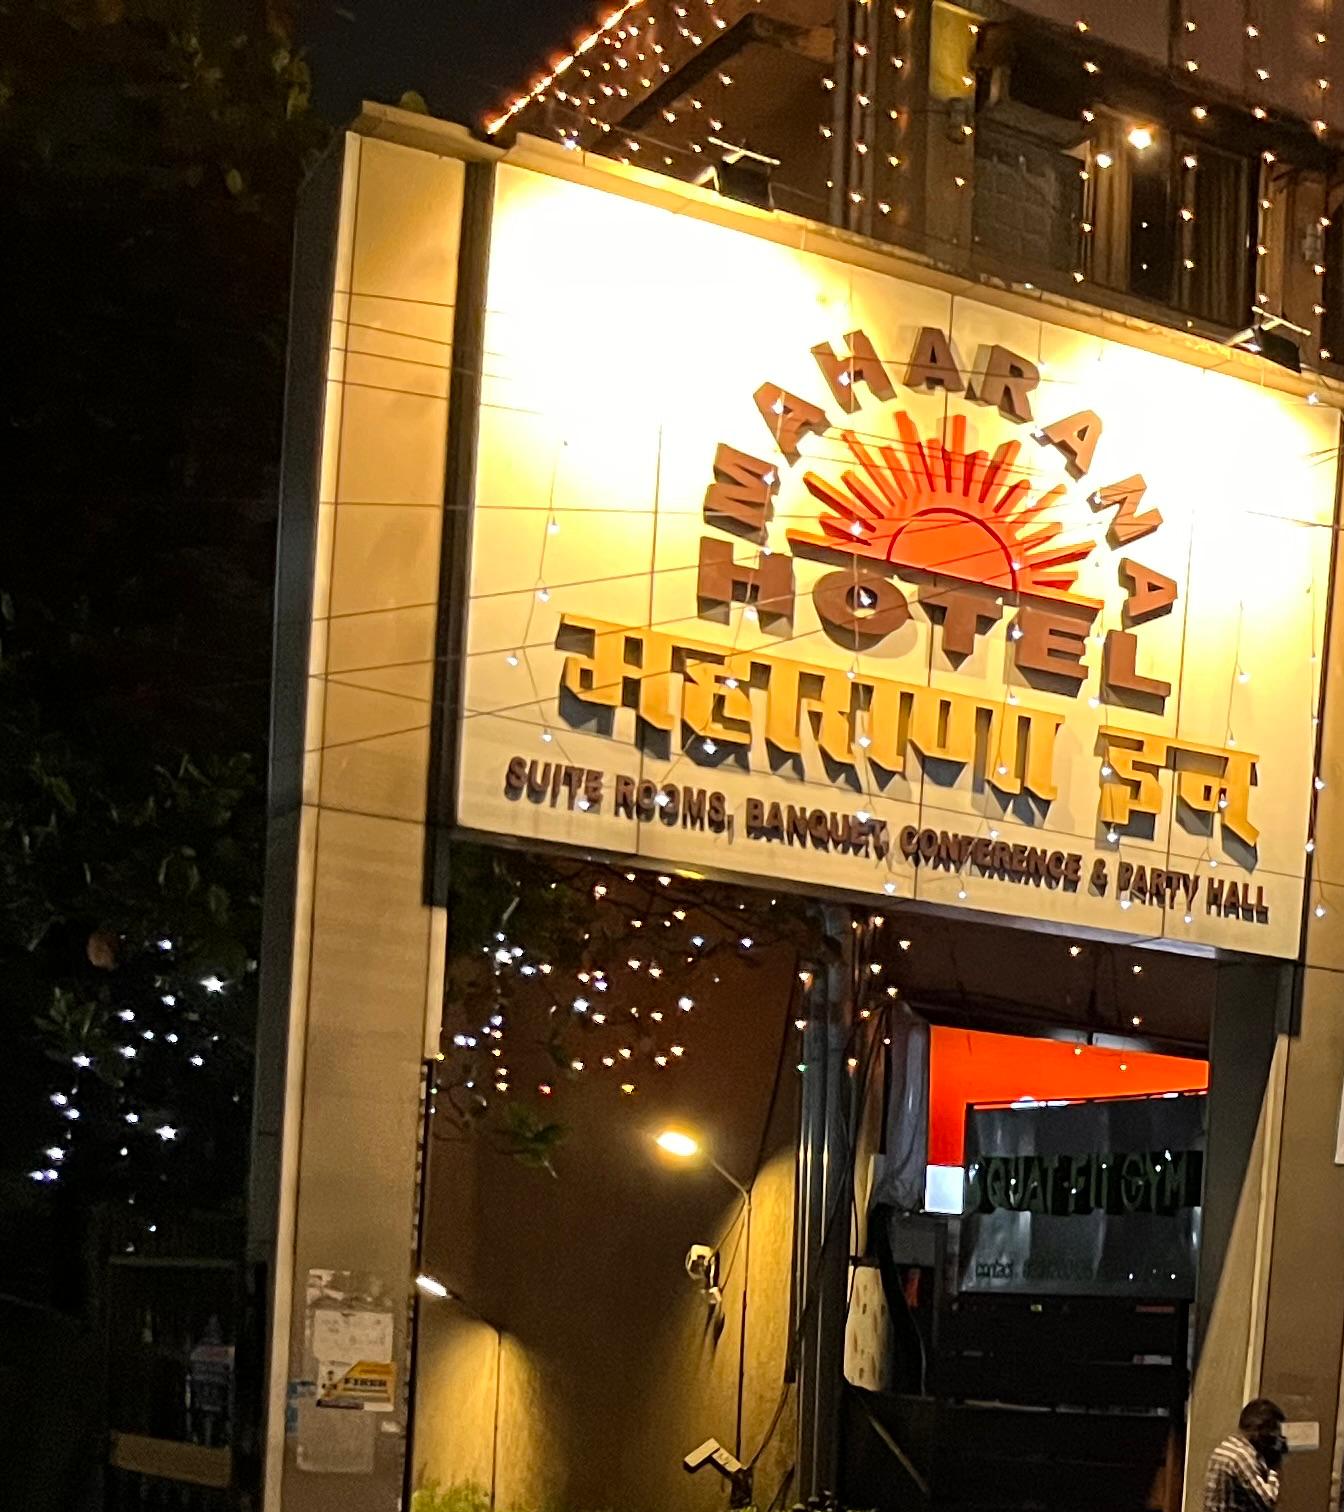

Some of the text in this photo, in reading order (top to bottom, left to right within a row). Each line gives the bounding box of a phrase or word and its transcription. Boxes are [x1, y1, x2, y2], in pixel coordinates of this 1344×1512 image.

[702, 326, 1178, 626] MAHARANA
[697, 535, 1173, 710] HOTEL
[556, 612, 1260, 850] महाराणा इन
[505, 755, 1270, 923] SUITE ROOMS, BANQUET, CONFERENCE & PARTY HALL
[1121, 1150, 1187, 1214] GYM
